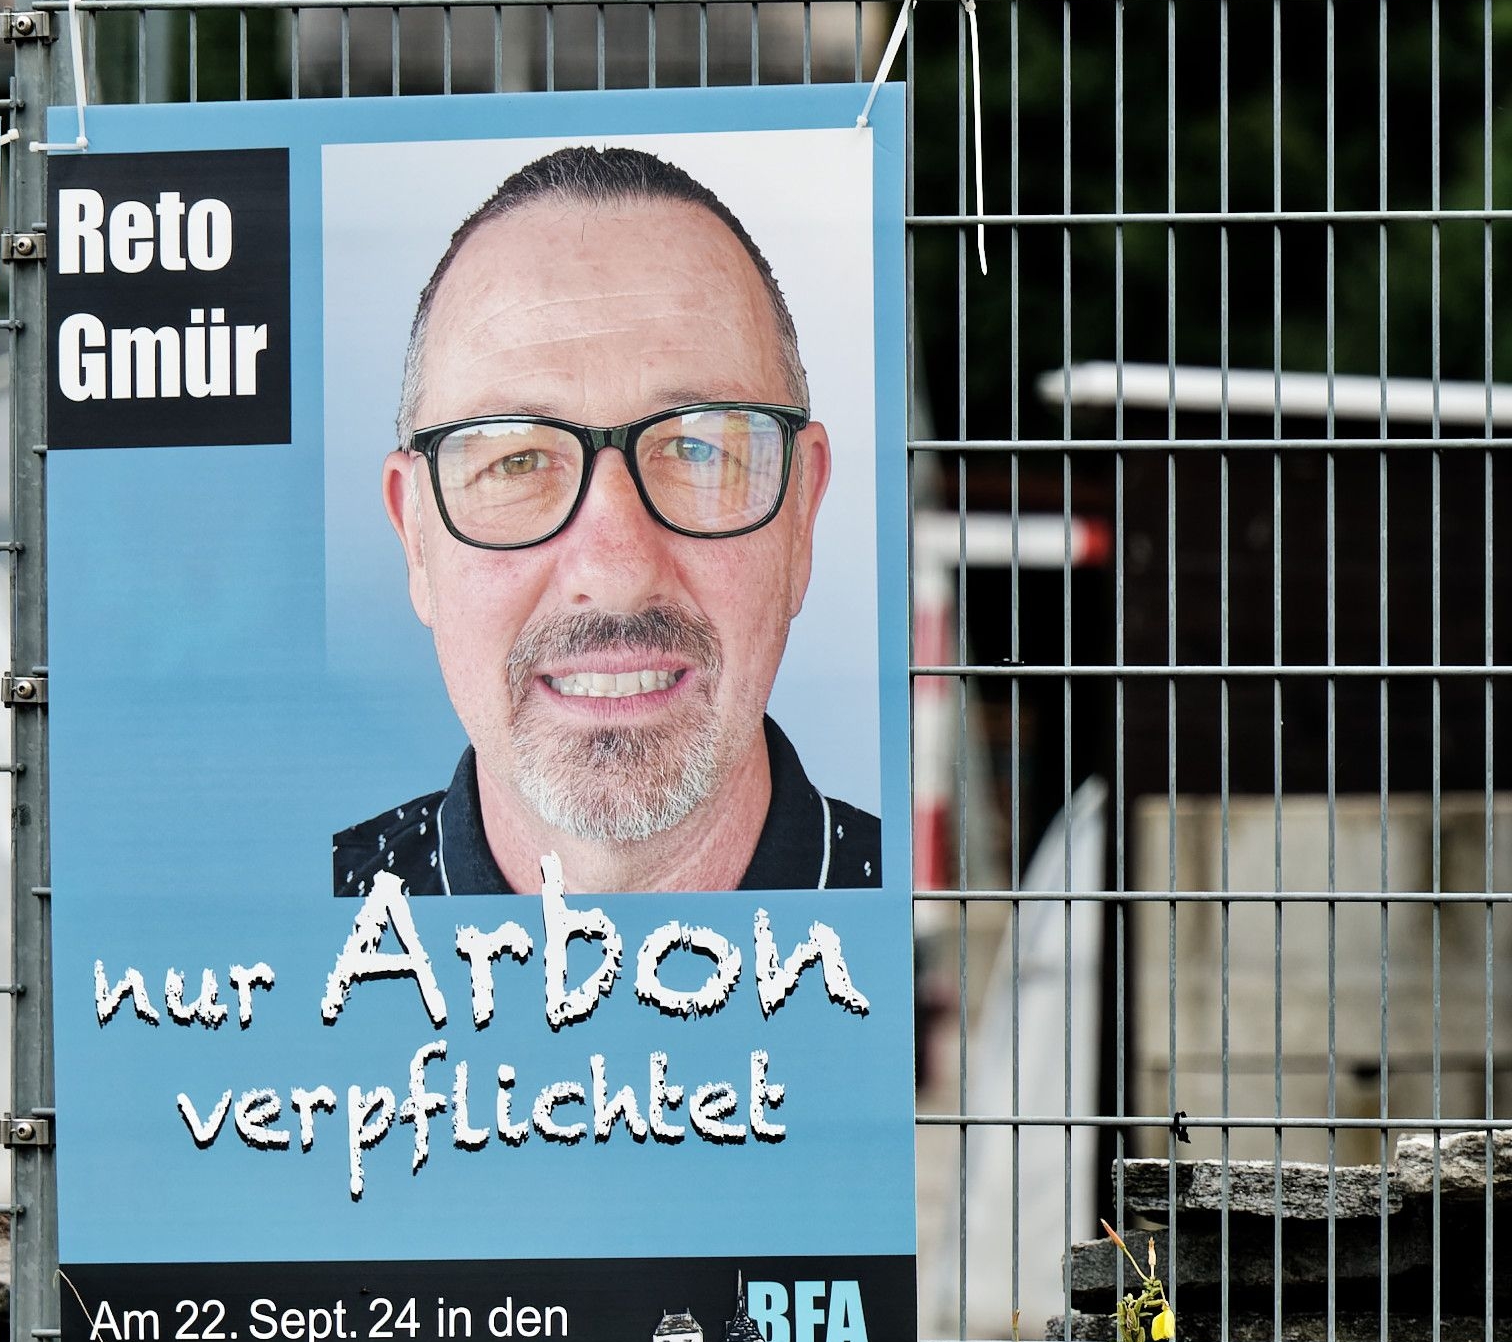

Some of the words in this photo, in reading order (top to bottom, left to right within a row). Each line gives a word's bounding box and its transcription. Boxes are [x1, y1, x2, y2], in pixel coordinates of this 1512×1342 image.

[59, 189, 232, 274] Reto
[58, 308, 268, 403] Gmür
[93, 960, 275, 1030] nur
[322, 852, 869, 1030] Arbon
[177, 1040, 786, 1201] verpflichtet
[90, 1301, 159, 1341] Am
[176, 1301, 238, 1340] 22.
[369, 1298, 421, 1339] 24
[439, 1298, 471, 1338] in
[489, 1297, 569, 1337] den
